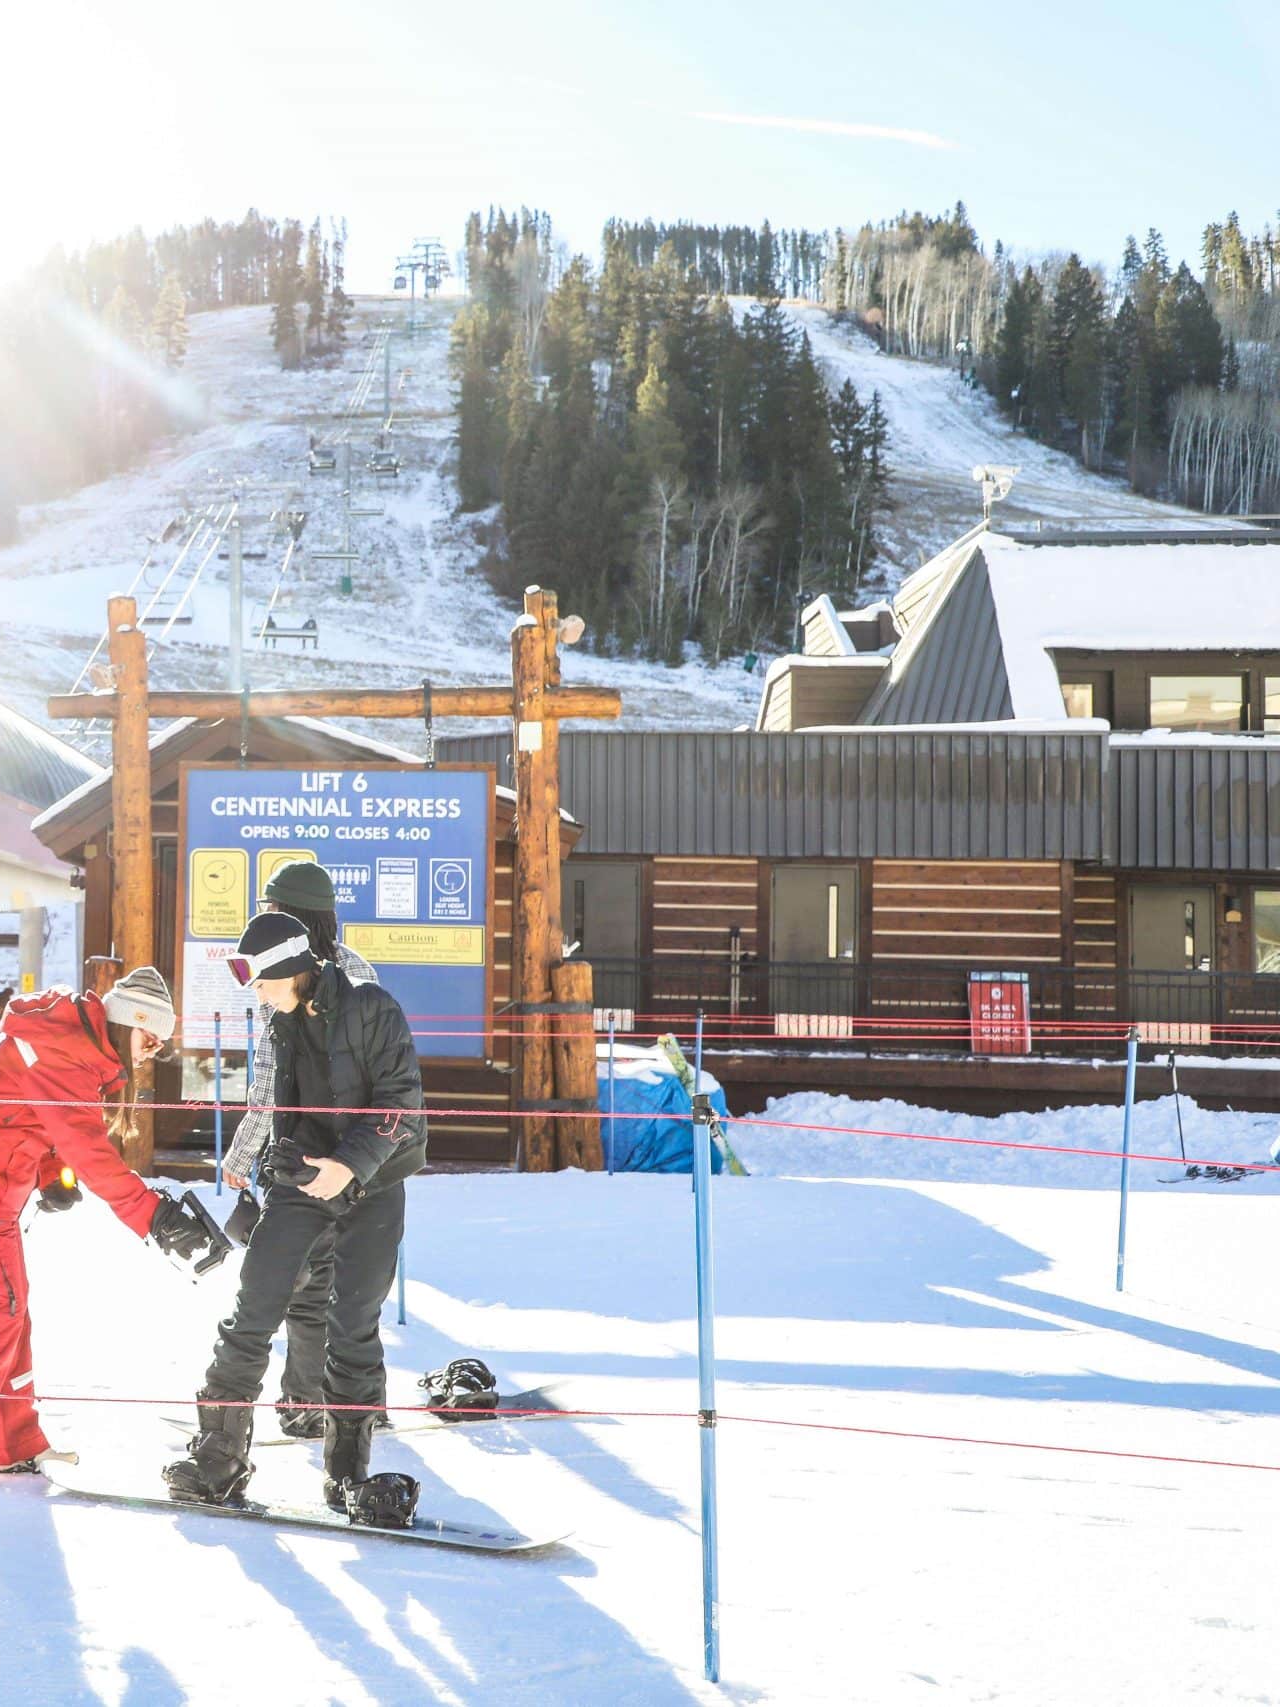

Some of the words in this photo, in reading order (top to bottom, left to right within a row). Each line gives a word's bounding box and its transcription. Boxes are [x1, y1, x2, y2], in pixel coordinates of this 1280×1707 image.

[301, 772, 343, 793] LIFT
[352, 772, 368, 793] 6
[211, 796, 352, 817] CENTENNIAL
[361, 798, 461, 818] EXPRESS
[240, 825, 290, 839] OPENS
[294, 824, 330, 839] 9:00
[335, 826, 390, 840] CLOSES
[395, 827, 431, 840] 4:00
[337, 887, 353, 896] SIX
